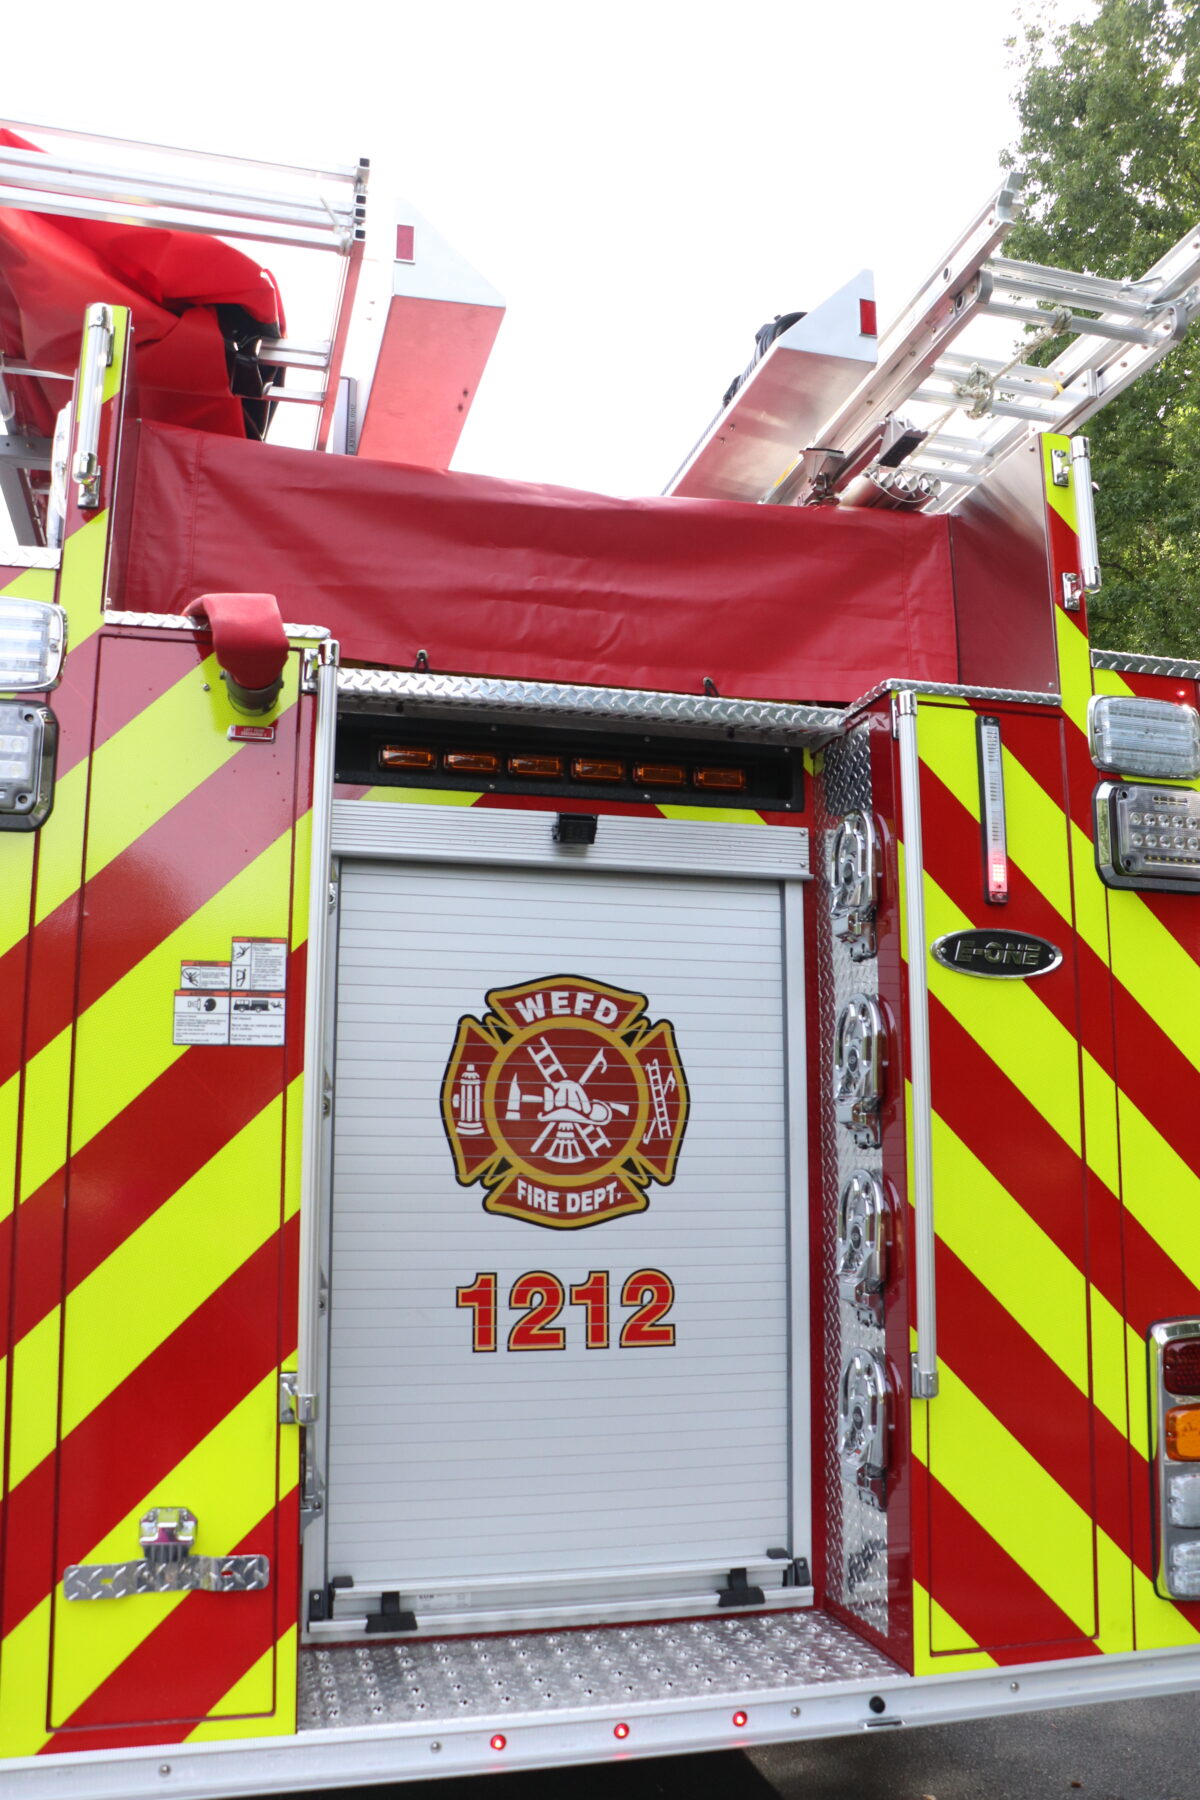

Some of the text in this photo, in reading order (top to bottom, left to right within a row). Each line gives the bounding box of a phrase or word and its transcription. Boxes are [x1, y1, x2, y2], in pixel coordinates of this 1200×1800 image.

[954, 940, 1041, 966] E-ONE
[514, 991, 619, 1025] WEFD
[516, 1178, 622, 1213] FIRE DEPT.
[456, 1268, 676, 1353] 1212
